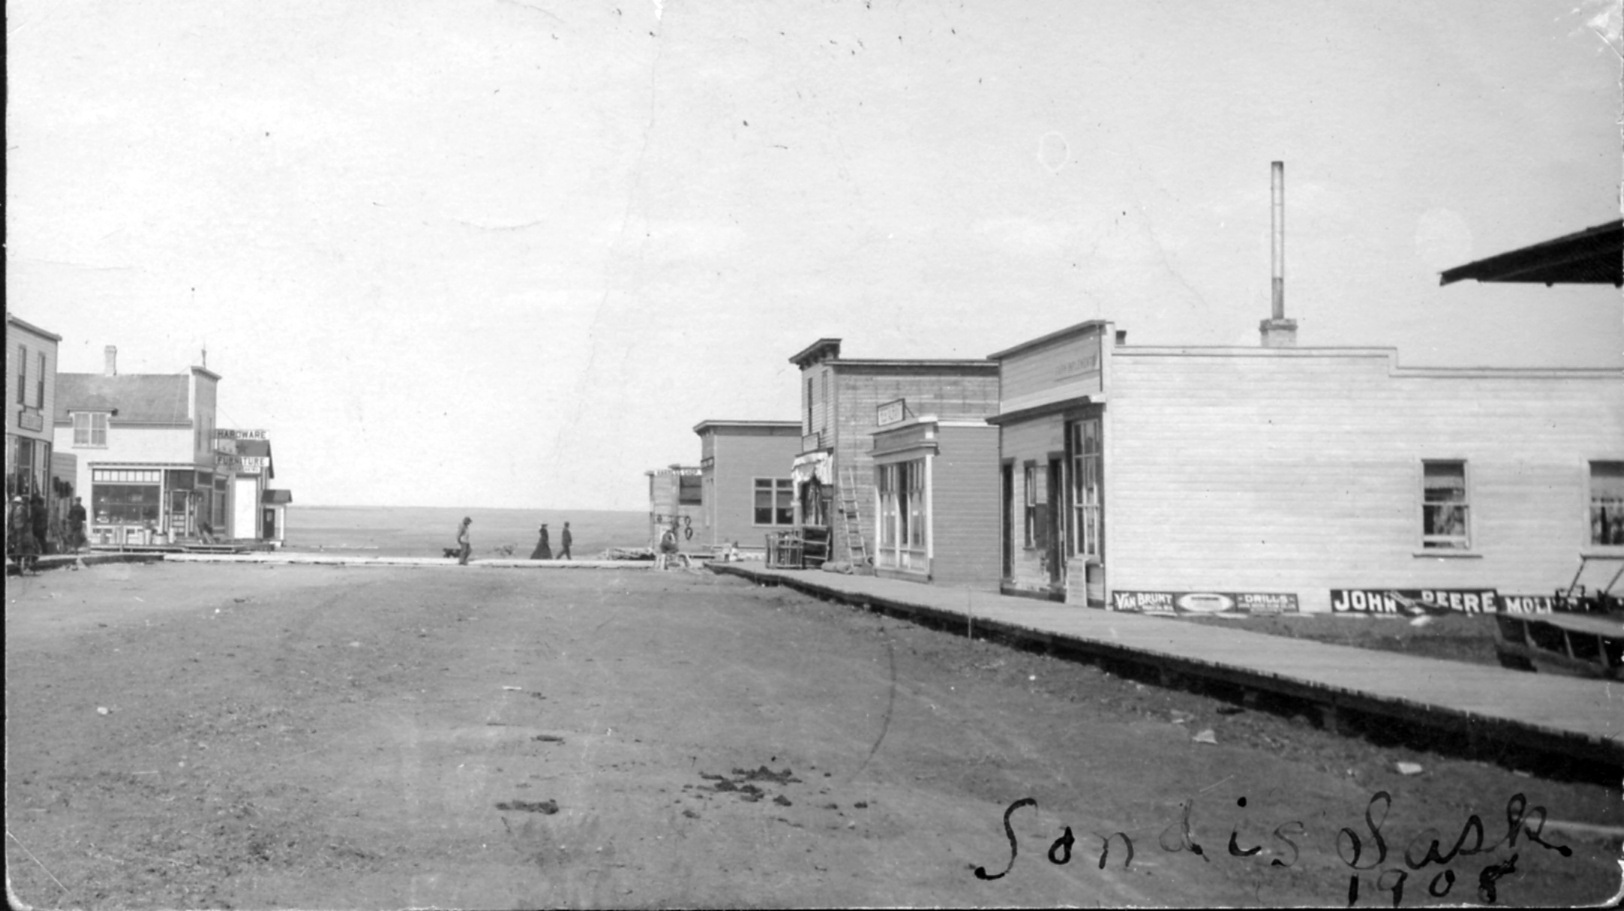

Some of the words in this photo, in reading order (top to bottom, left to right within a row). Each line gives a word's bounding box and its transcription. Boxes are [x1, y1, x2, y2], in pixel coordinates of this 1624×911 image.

[217, 429, 267, 439] HARDWARE
[217, 456, 266, 466] FURNITURE
[1244, 594, 1288, 604] DRILLS
[1333, 589, 1398, 613] JOHN
